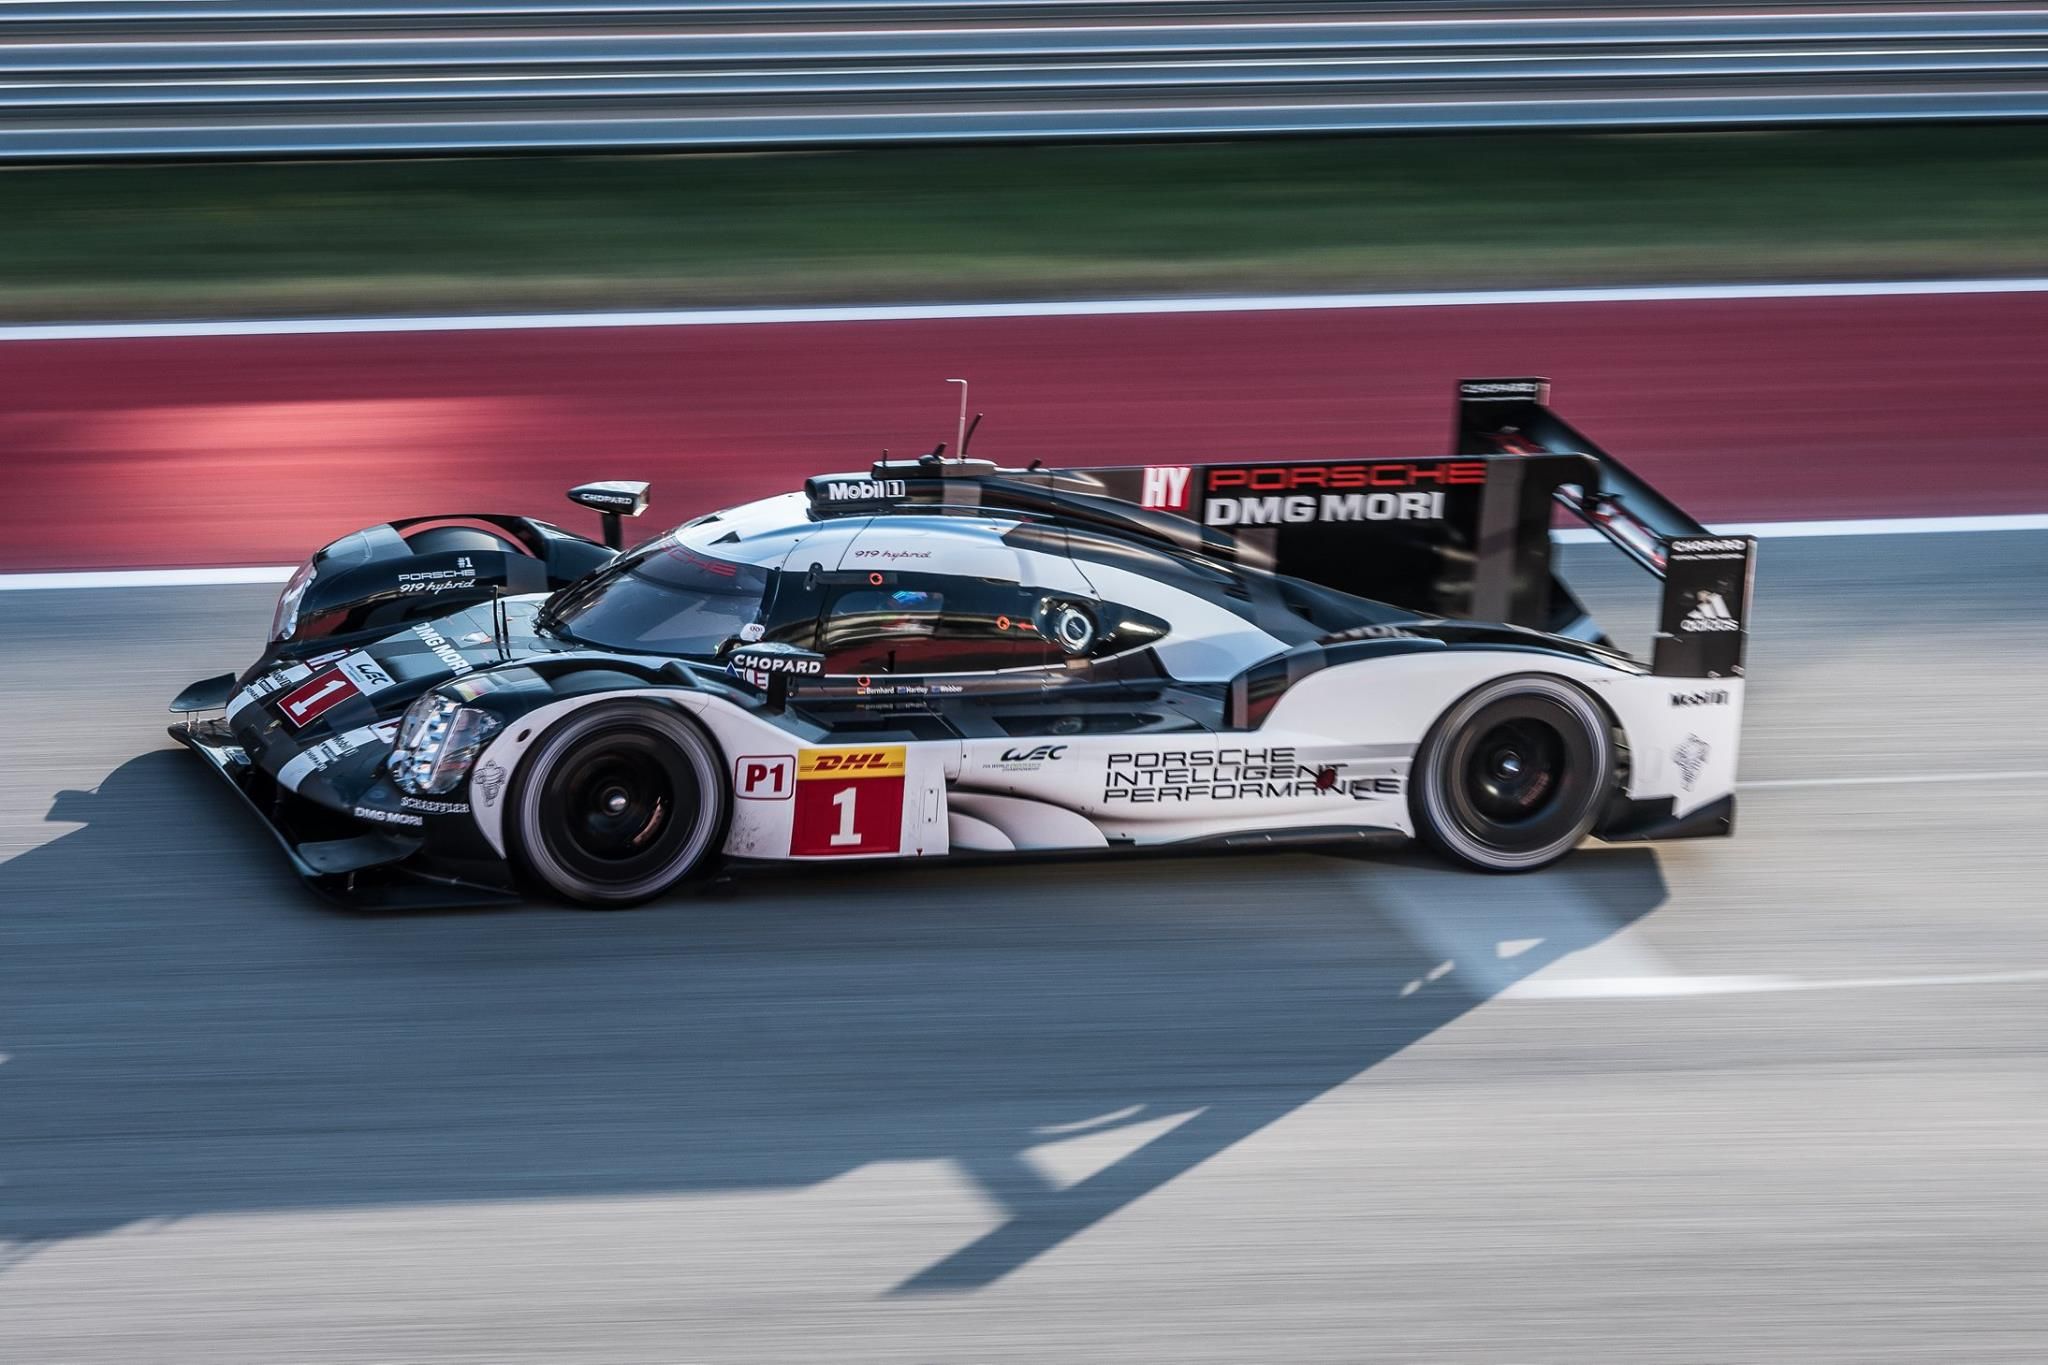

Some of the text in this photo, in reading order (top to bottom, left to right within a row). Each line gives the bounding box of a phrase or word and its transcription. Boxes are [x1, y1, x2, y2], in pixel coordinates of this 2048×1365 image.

[1207, 462, 1488, 491] PORSCHE
[829, 480, 904, 500] Mobil 1
[1143, 467, 1192, 508] HY
[1204, 491, 1446, 526] DMG MORI
[458, 557, 473, 568] #1
[855, 550, 932, 561] 919 hybrid
[398, 569, 476, 581] PORSCHE
[400, 579, 476, 594] 919 hybrid
[432, 643, 474, 676] MORI
[733, 654, 821, 674] CHOPARD
[356, 664, 389, 685] WEC
[289, 680, 347, 716] 1
[866, 687, 895, 695] Bernhard
[814, 753, 889, 771] DHL
[1000, 745, 1068, 761] WEC
[1107, 747, 1297, 770] PORSCHE
[745, 763, 784, 793] P1
[1105, 763, 1349, 787] INTELLIGENT
[354, 807, 424, 826] DMG MORI
[830, 787, 862, 846] 1
